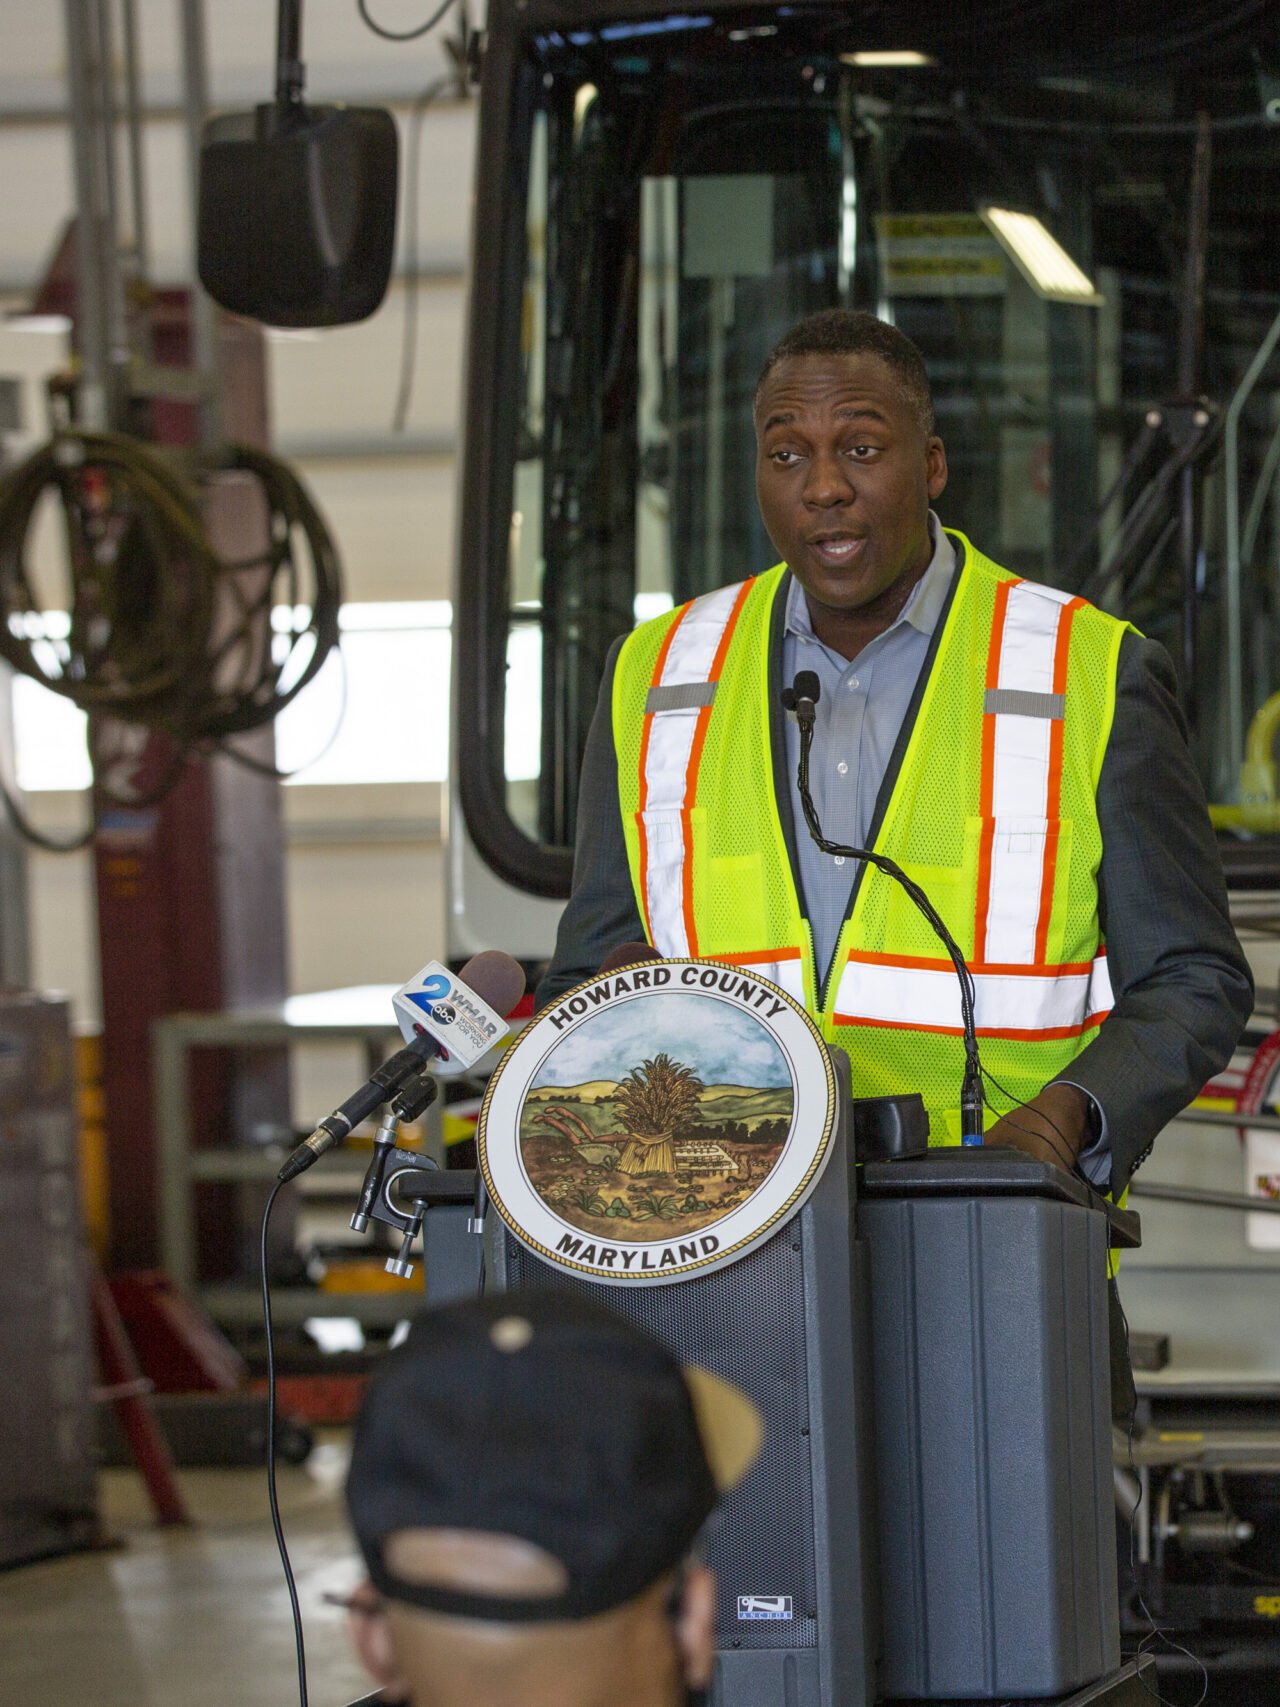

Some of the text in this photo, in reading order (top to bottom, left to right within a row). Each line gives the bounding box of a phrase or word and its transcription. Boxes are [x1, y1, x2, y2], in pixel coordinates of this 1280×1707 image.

[404, 974, 451, 1016] 2
[434, 1005, 454, 1024] abc
[450, 988, 498, 1038] WMAR
[549, 966, 788, 1031] HOWARD COUNTY
[455, 1020, 484, 1049] FOR YOU
[459, 1014, 489, 1045] WORKING
[555, 1232, 721, 1271] MARYLAND
